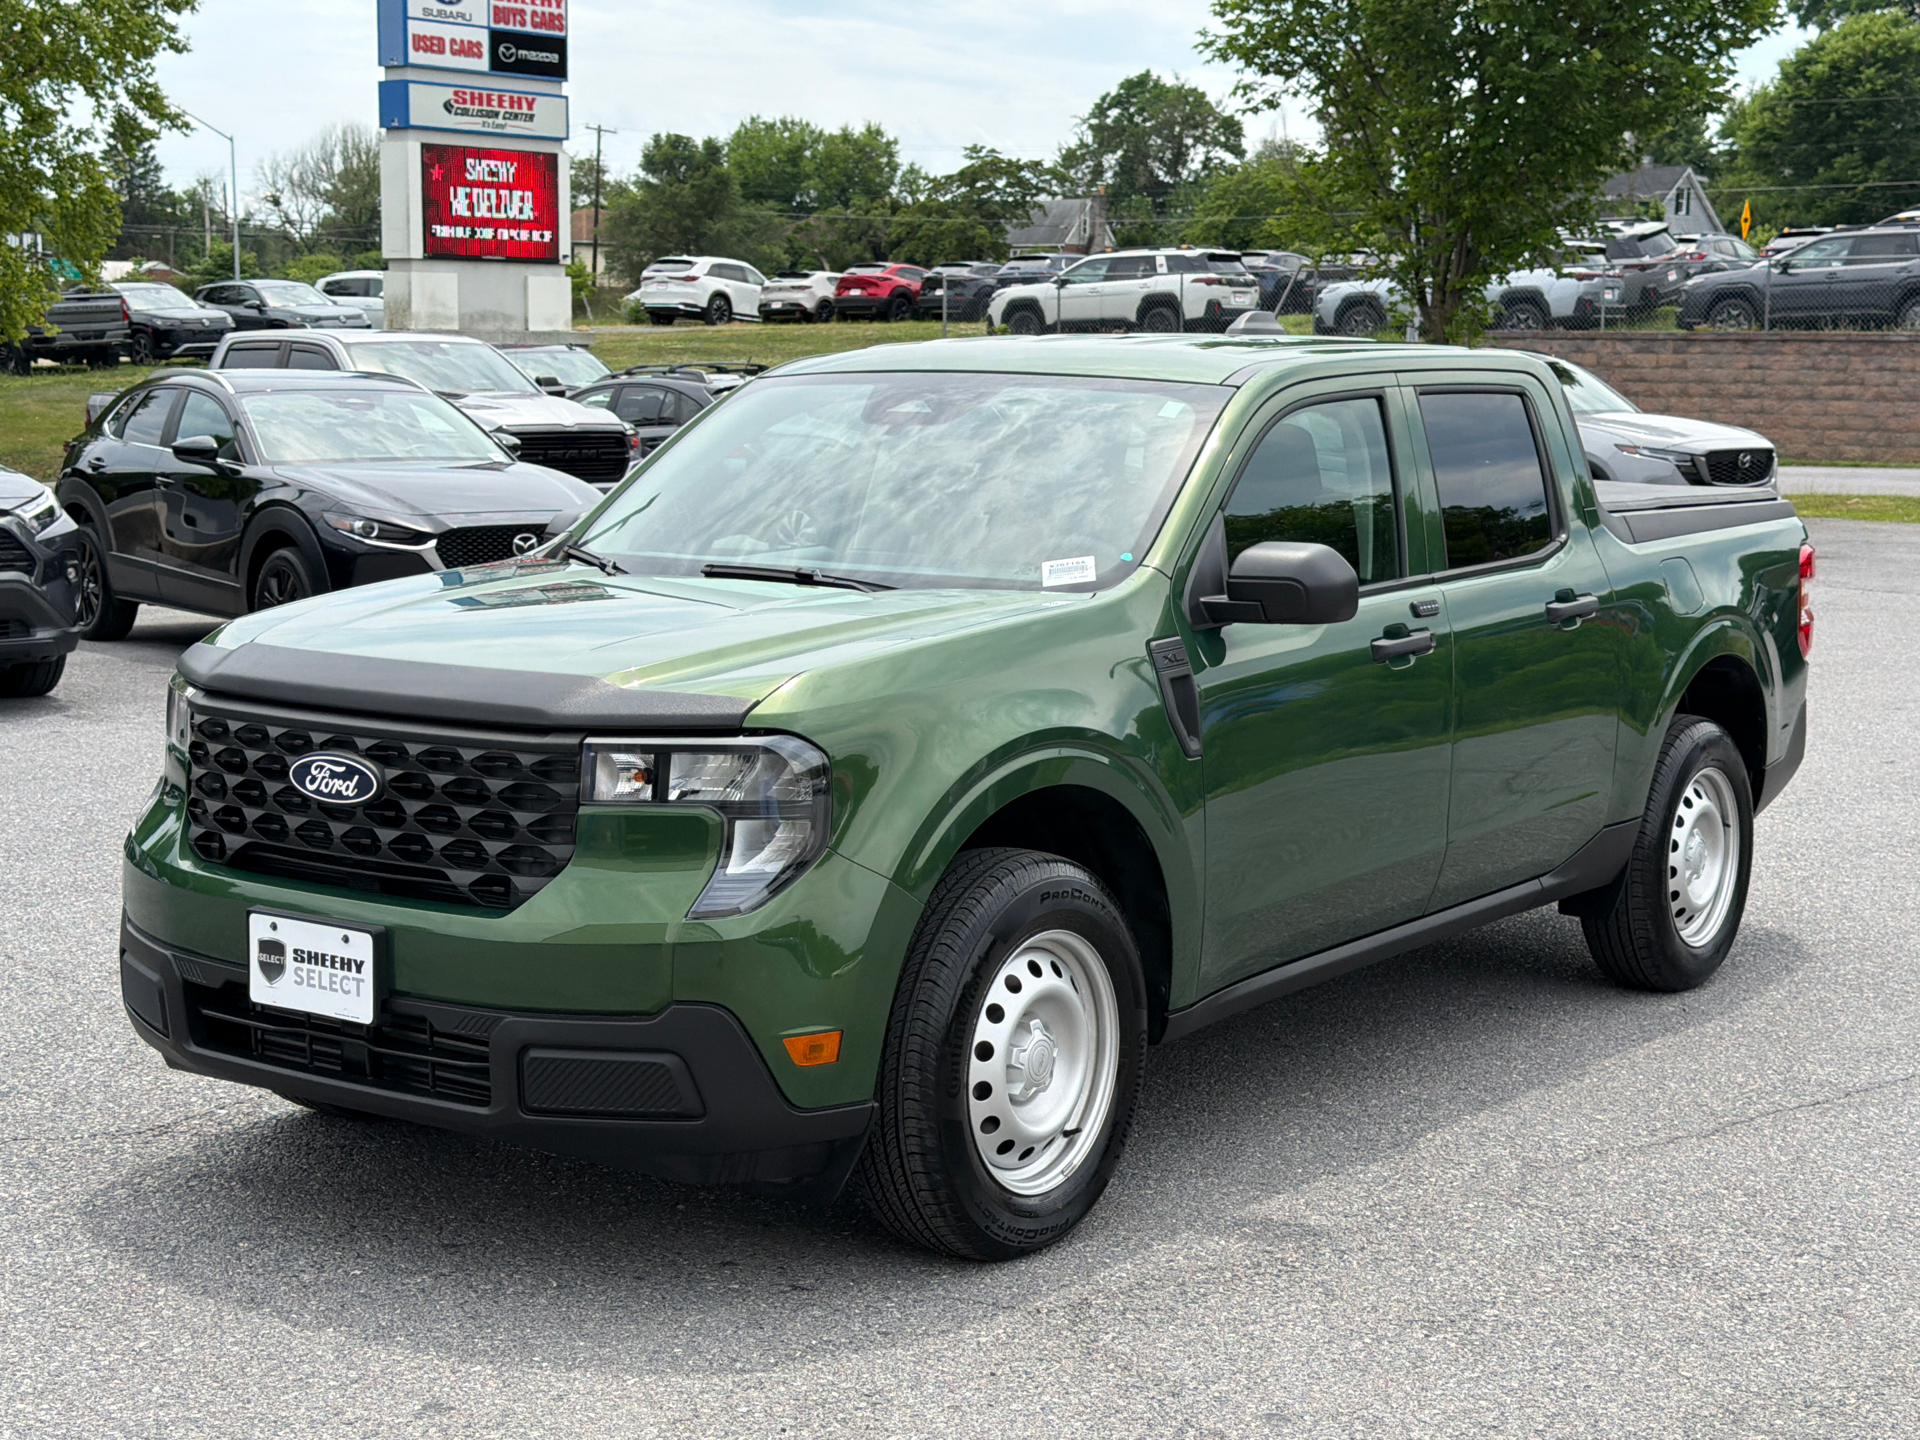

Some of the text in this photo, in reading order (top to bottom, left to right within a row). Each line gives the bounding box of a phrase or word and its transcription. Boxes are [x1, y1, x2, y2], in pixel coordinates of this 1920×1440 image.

[422, 7, 472, 22] SUBARU
[493, 5, 564, 33] BUYS CARS
[412, 33, 483, 59] USED CARS
[517, 49, 559, 64] mazda
[453, 89, 537, 111] SHEEHY
[454, 106, 535, 122] COLLISION CENTER
[465, 158, 517, 183] SHEEHY
[472, 187, 534, 220] DELIVER
[1162, 653, 1185, 665] XL
[305, 761, 359, 797] Ford
[259, 952, 286, 965] SELECT
[292, 948, 365, 975] SHEEHY
[293, 966, 365, 998] SELECT
